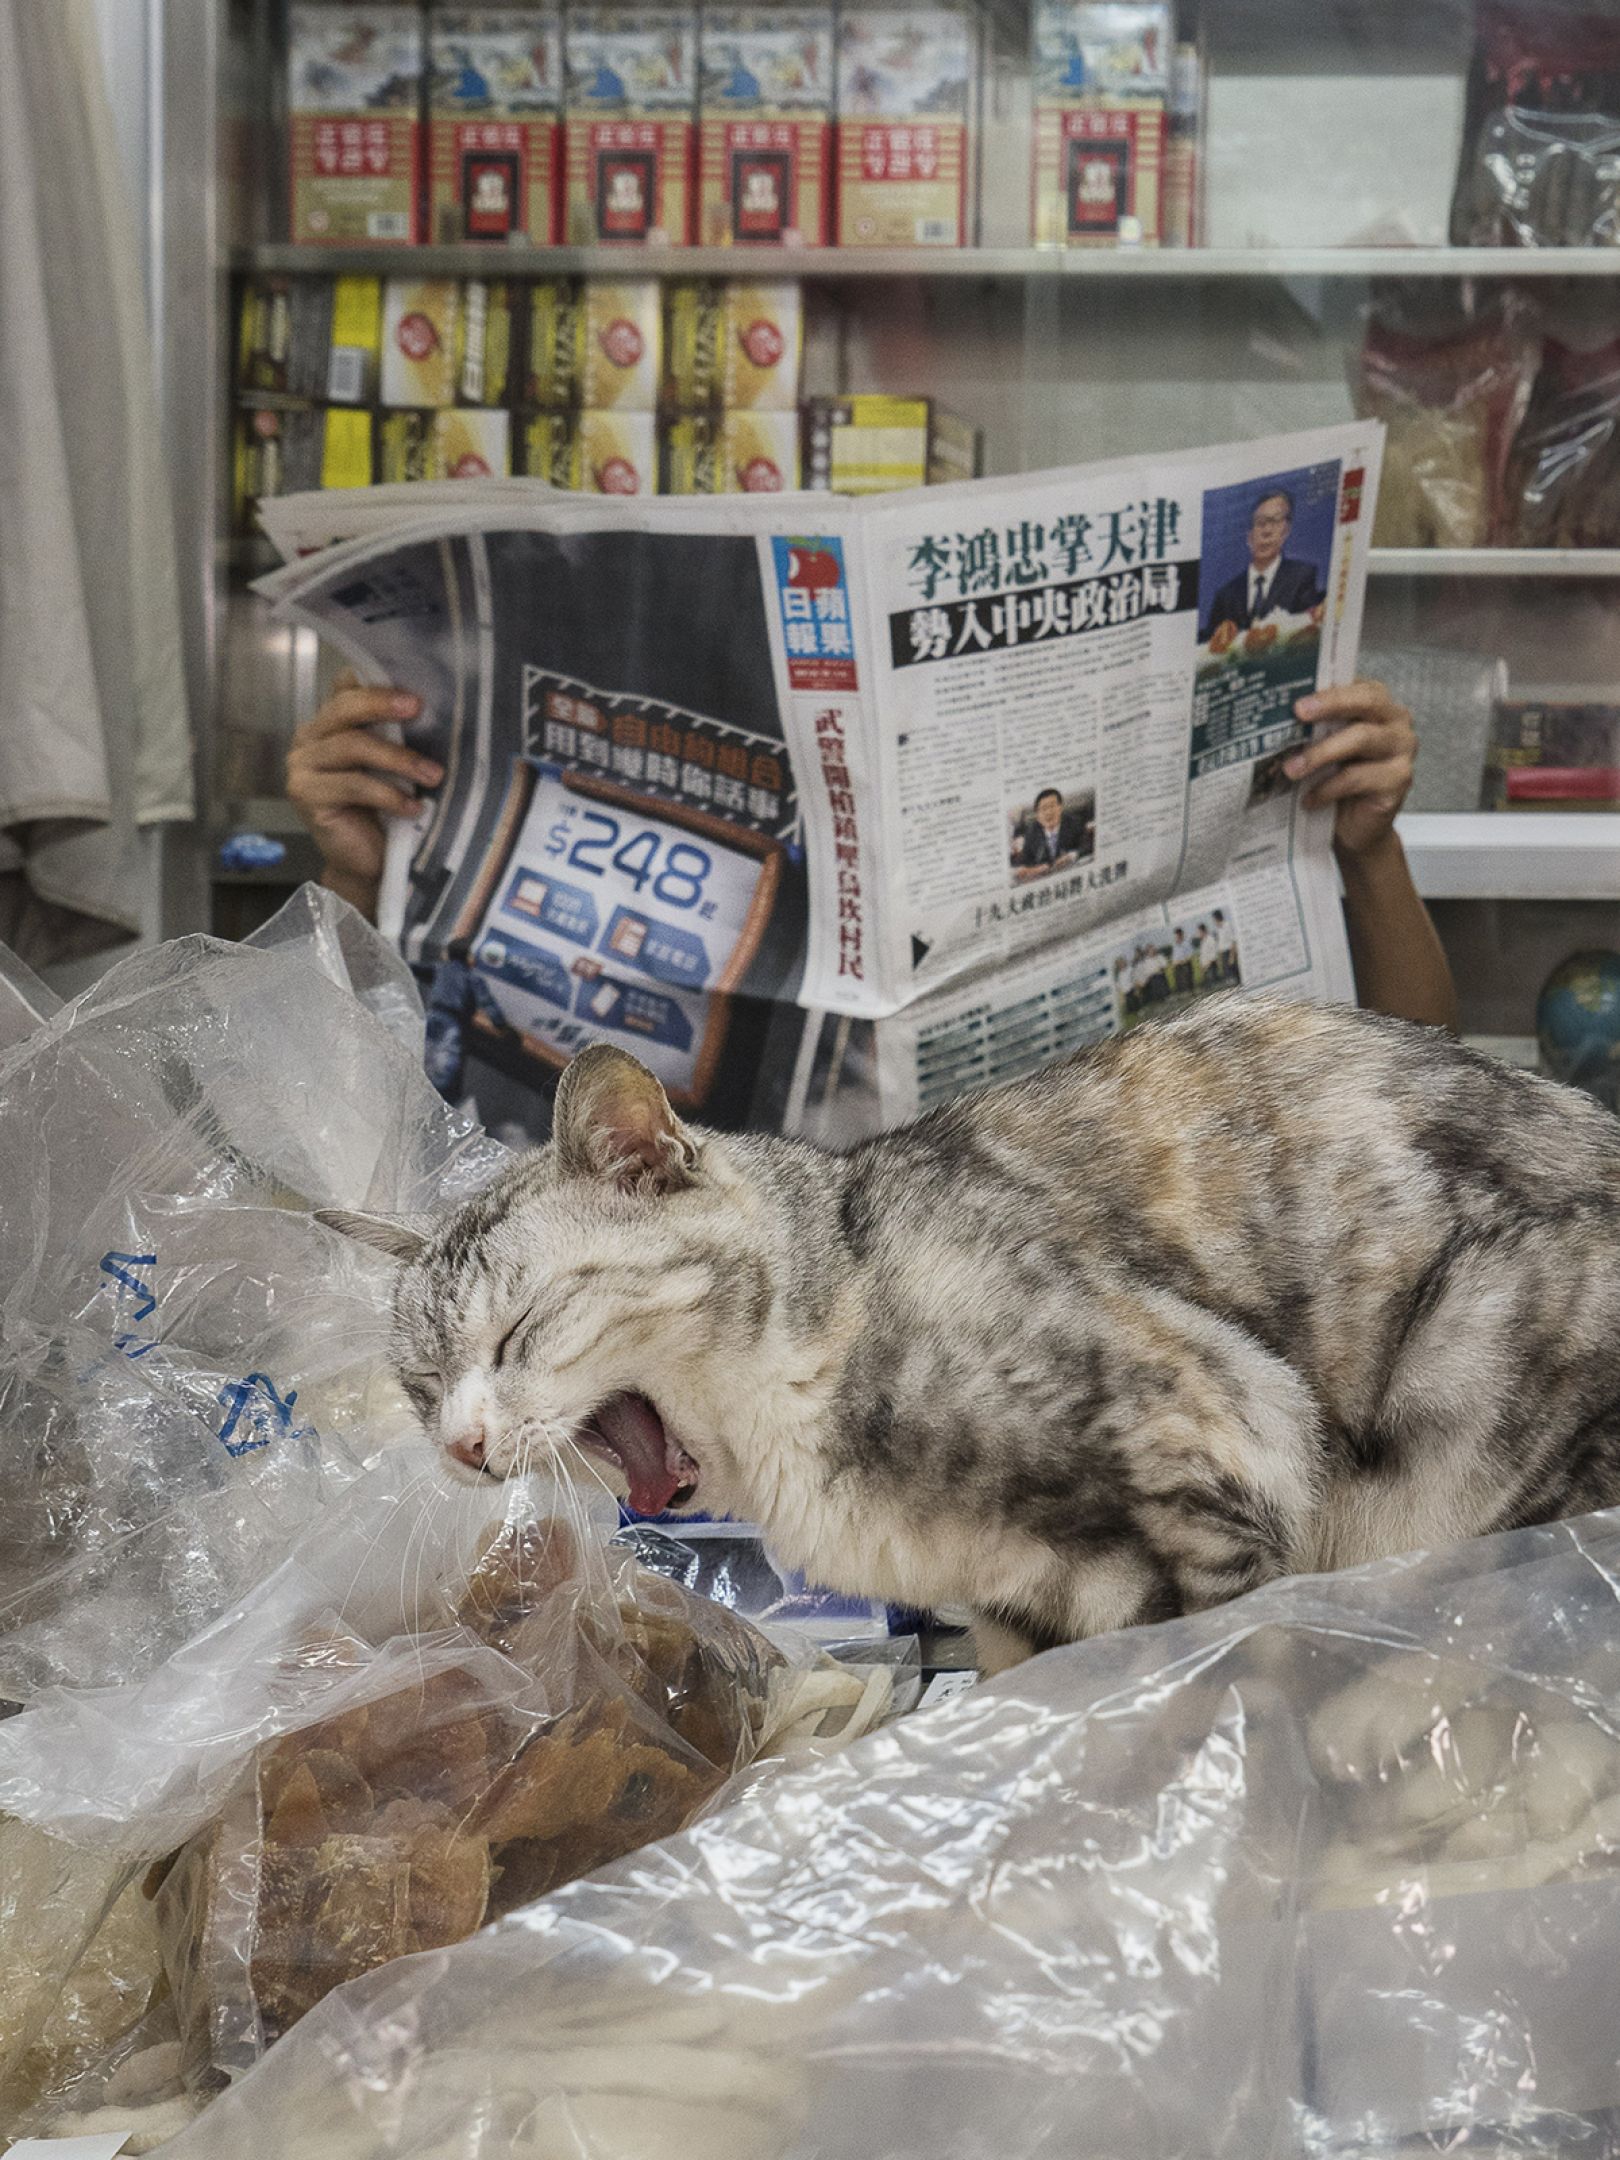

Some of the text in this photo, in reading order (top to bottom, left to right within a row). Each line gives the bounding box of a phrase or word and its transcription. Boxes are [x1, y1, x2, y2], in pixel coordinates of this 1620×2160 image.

[905, 497, 1183, 601] 李鴻忠掌天津
[909, 565, 1181, 662] 勢入中央政治局
